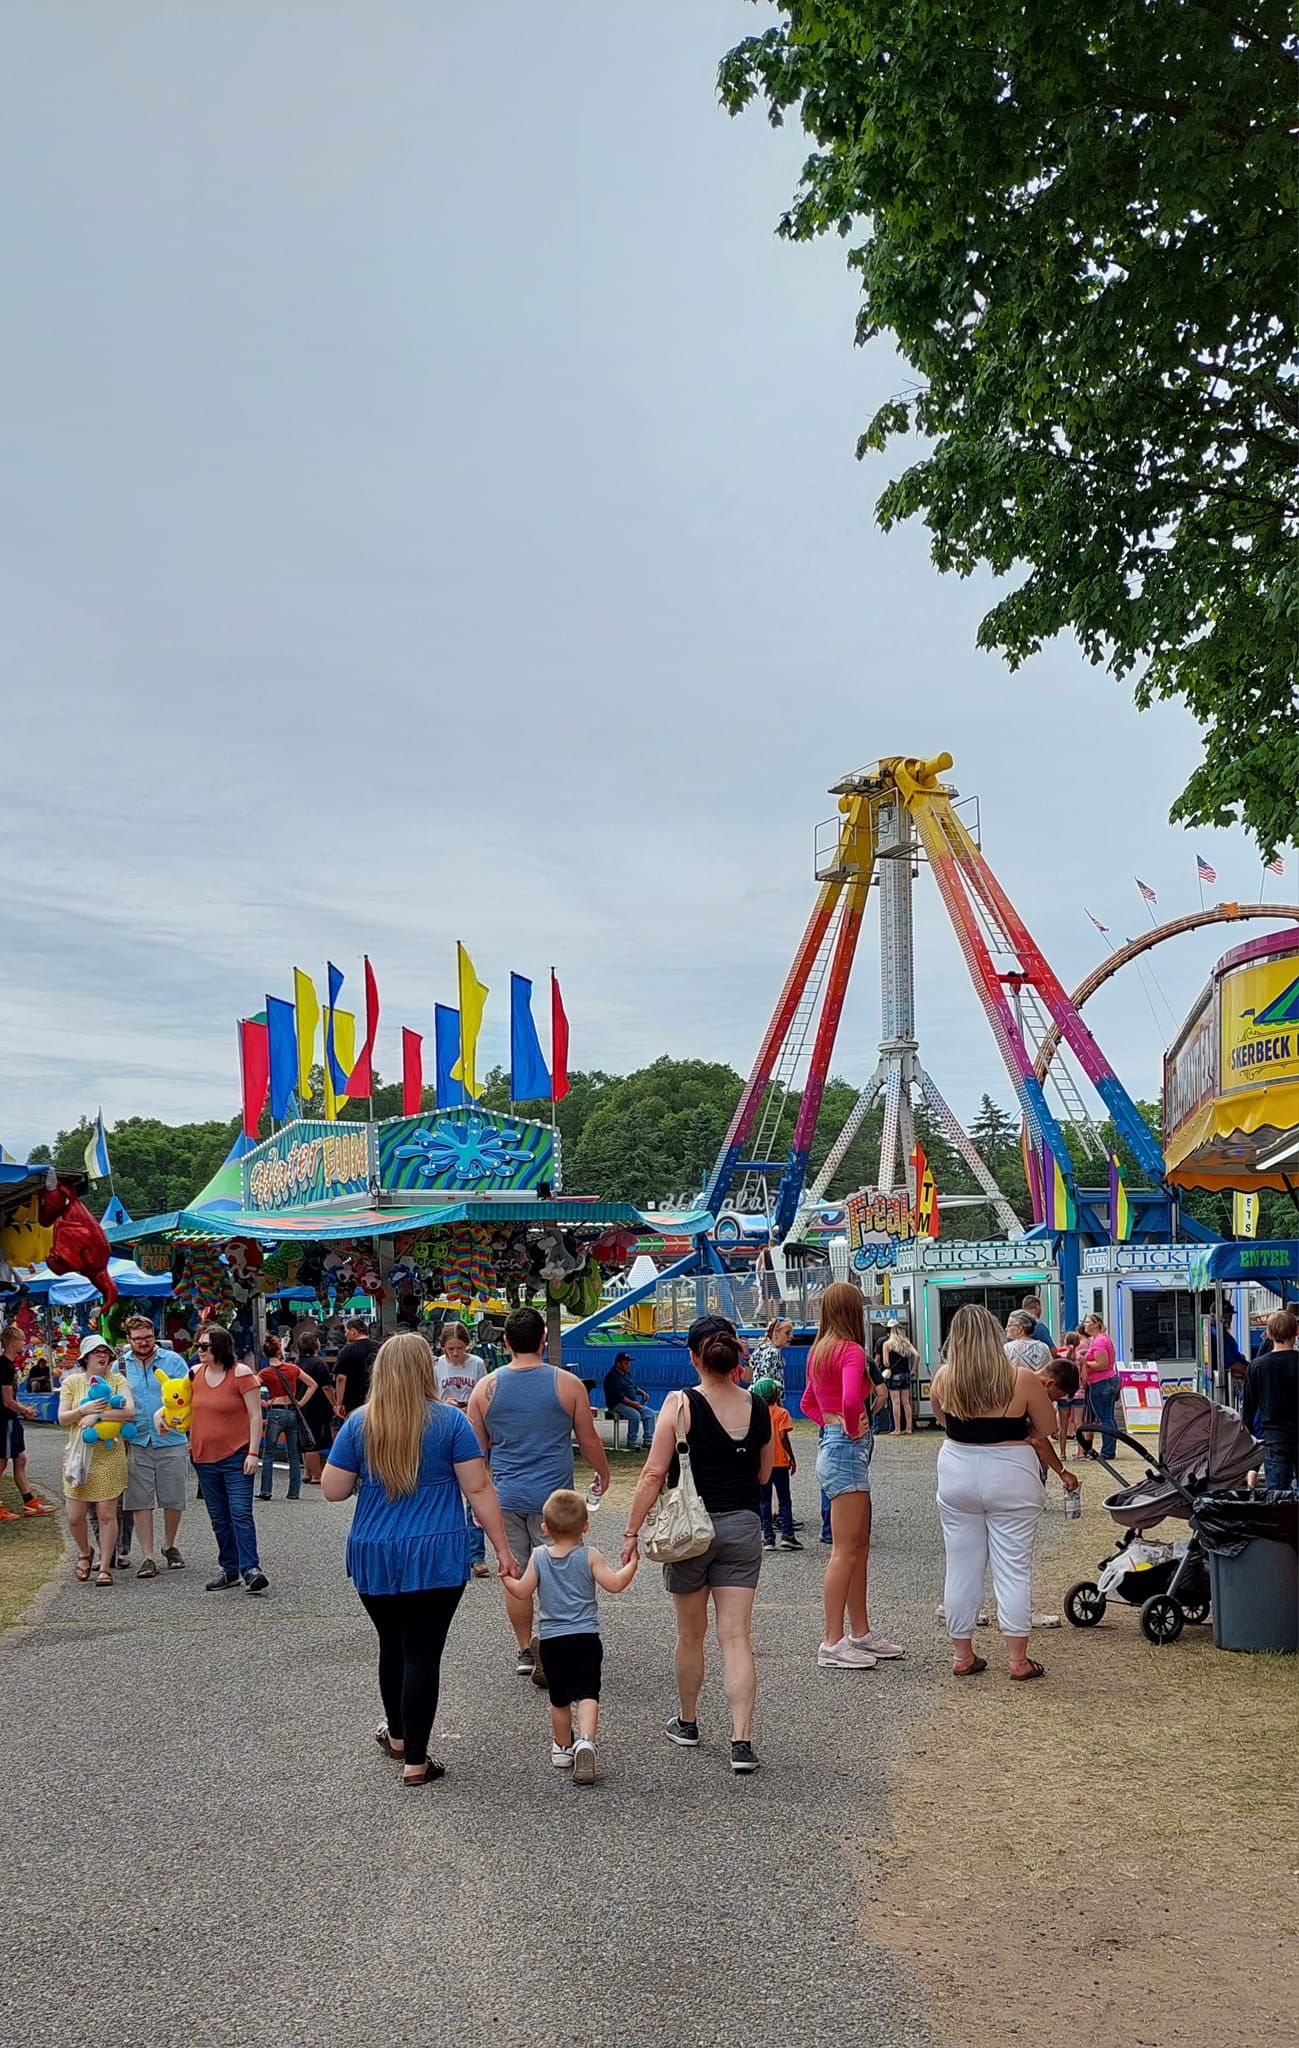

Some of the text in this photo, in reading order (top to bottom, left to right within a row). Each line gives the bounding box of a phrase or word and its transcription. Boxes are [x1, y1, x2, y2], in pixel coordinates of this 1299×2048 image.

[1231, 1034, 1291, 1071] SKERBECK
[322, 1131, 368, 1187] FUN
[848, 1193, 917, 1252] Freak
[141, 1255, 170, 1272] FUN
[932, 1247, 1038, 1264] TICKETS
[1125, 1251, 1195, 1265] TICKE
[1239, 1250, 1291, 1268] ENTER
[875, 1310, 898, 1319] ATM
